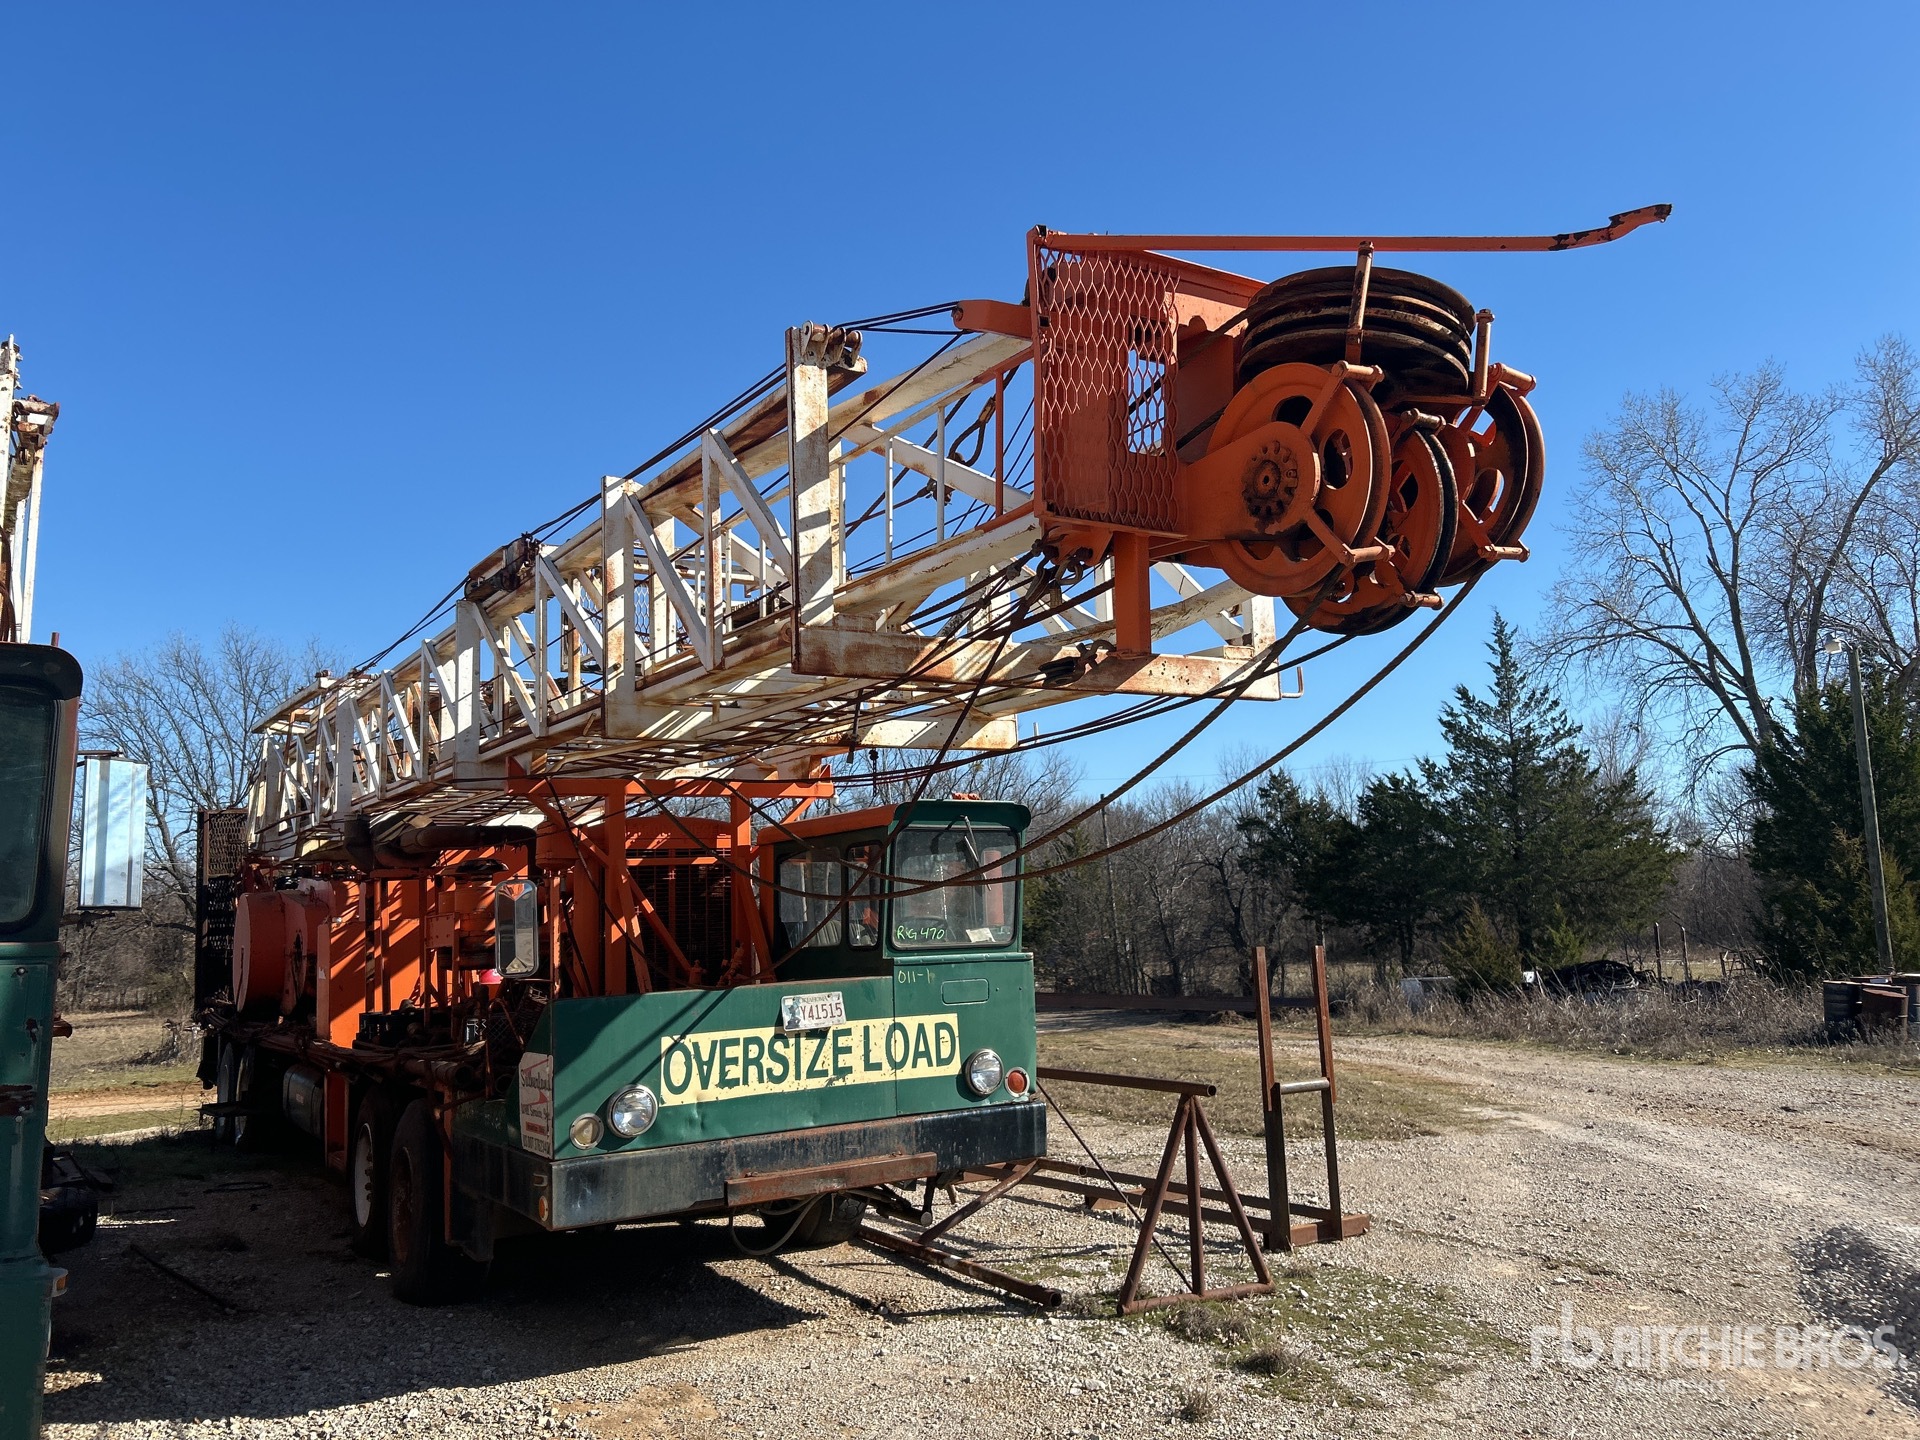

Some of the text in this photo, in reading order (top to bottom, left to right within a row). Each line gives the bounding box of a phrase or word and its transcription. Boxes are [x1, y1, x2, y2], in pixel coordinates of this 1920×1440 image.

[920, 927, 945, 940] 470
[800, 1002, 843, 1021] Y41515
[663, 1021, 958, 1096] OVERSIZE LOAD
